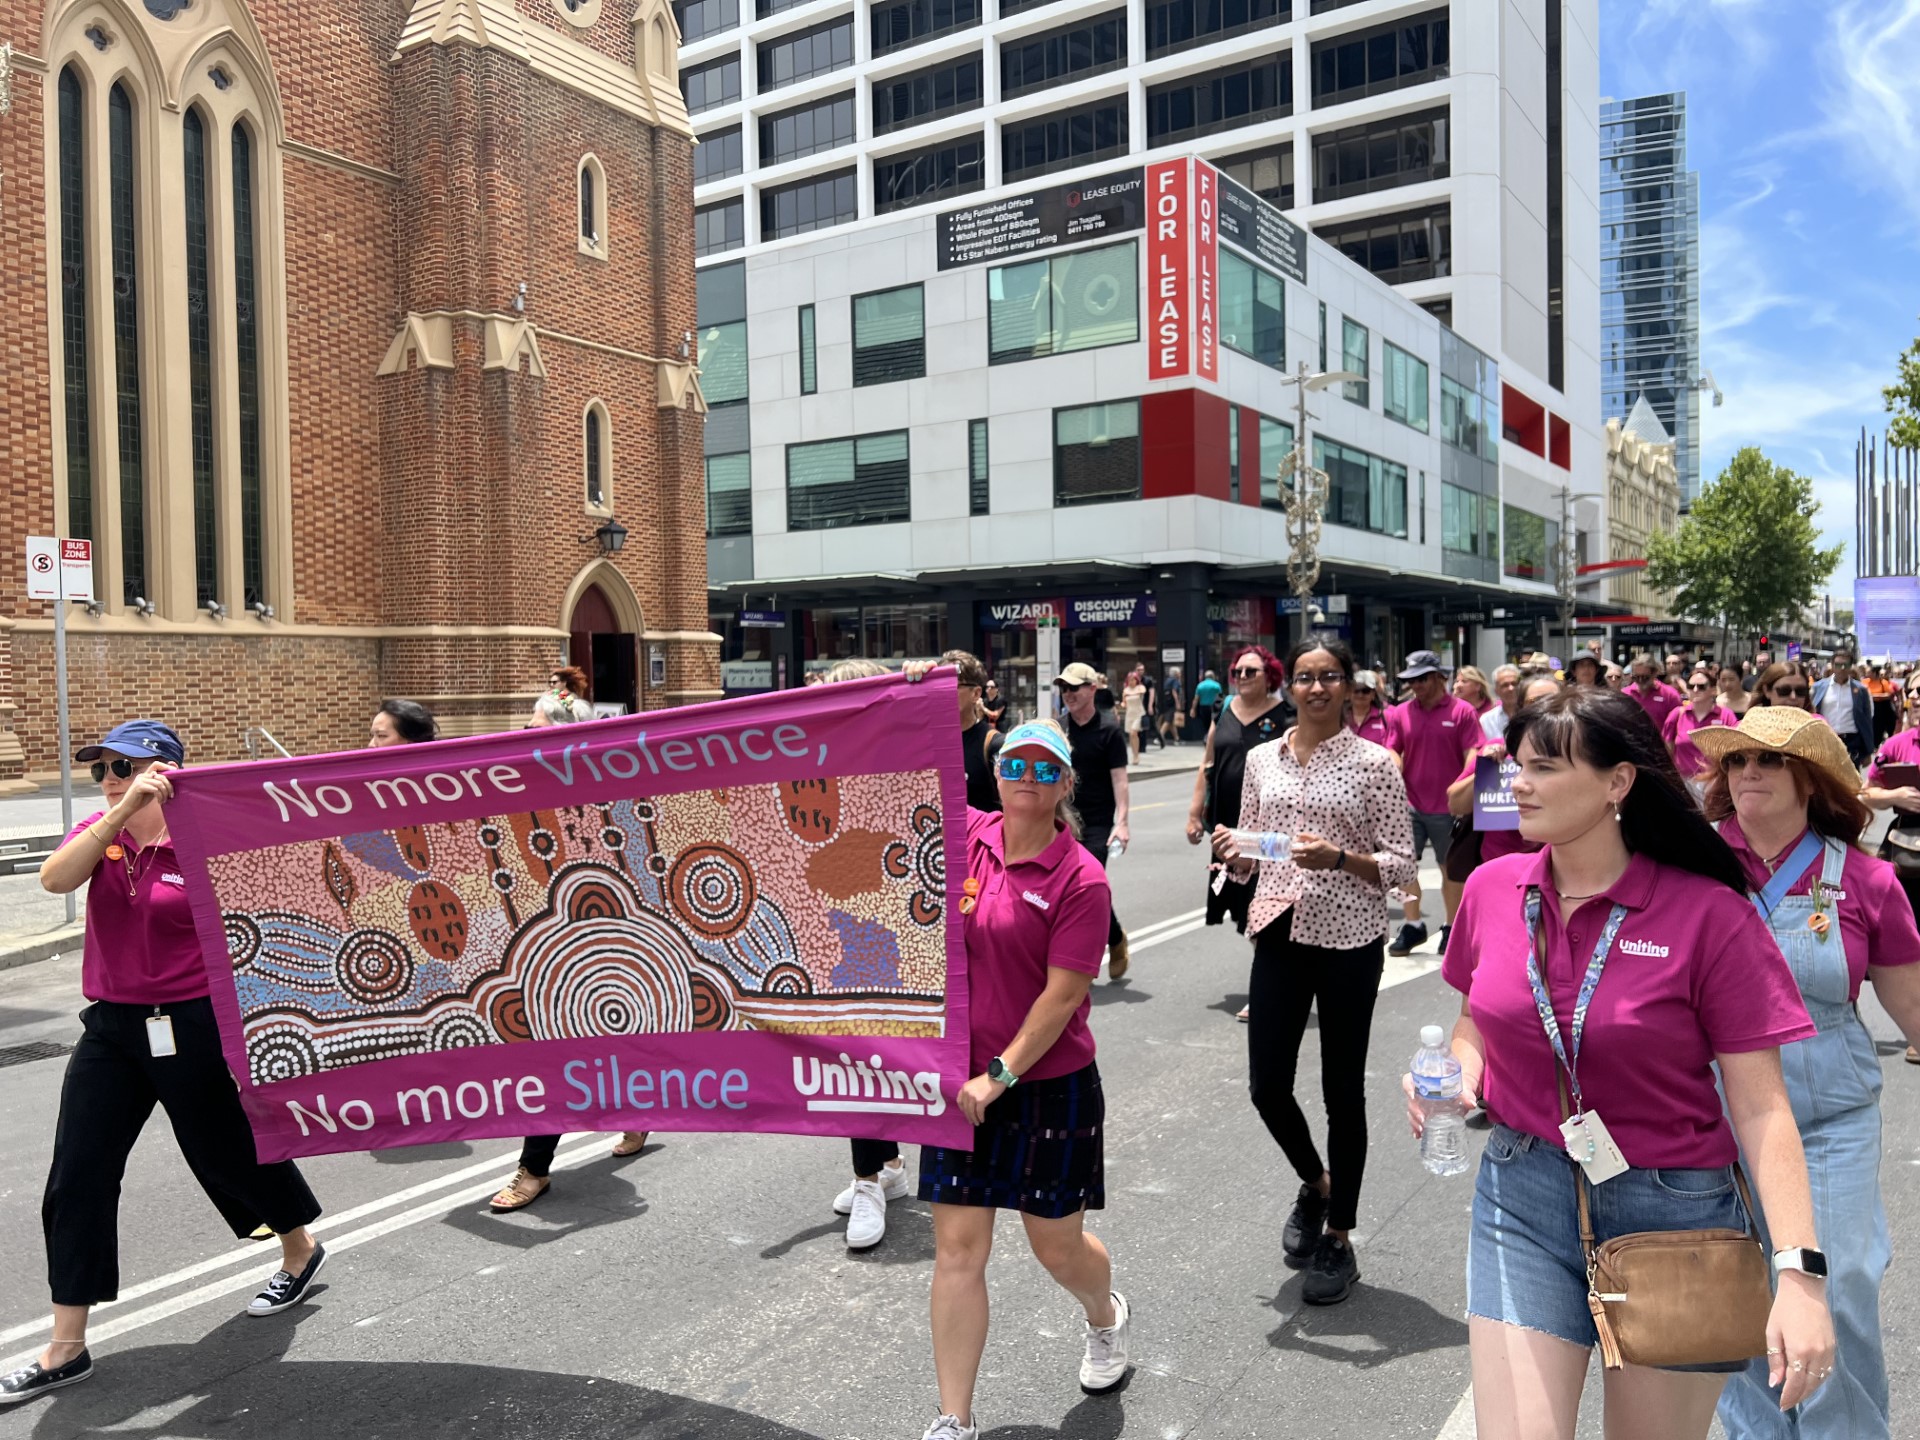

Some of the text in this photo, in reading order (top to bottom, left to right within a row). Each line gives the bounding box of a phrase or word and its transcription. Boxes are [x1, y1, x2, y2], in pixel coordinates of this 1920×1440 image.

[1082, 180, 1141, 201] LEASE EQUITY
[955, 198, 1034, 222] Fully Furnished Offices
[955, 211, 1024, 232] Areas from 400sqm
[955, 231, 977, 242] Whole
[977, 226, 1000, 237] Floors
[1000, 223, 1009, 232] of
[955, 228, 1041, 252] Impressive EOT Facilities
[956, 252, 968, 262] 4.5
[968, 250, 984, 259] Star
[1009, 240, 1035, 251] energy
[1035, 234, 1058, 245] rating
[1157, 170, 1180, 368] FOR LEASE
[1200, 174, 1212, 371] FOR LEASE
[64, 549, 88, 559] ZONE
[66, 541, 85, 550] BUS
[991, 603, 1053, 620] WIZARD
[1074, 598, 1138, 613] DISCOUNT
[1281, 597, 1323, 608] DOCOR
[744, 612, 764, 620] WIZARD
[1078, 610, 1133, 623] CHEMIST
[1620, 624, 1674, 635] WESLEY QUARTER
[263, 724, 828, 823] No more Violence,
[1479, 791, 1517, 804] HURT
[1808, 886, 1847, 900] Uiting
[1618, 938, 1670, 958] Uniting
[285, 1052, 947, 1137] No more Silence Uniting
